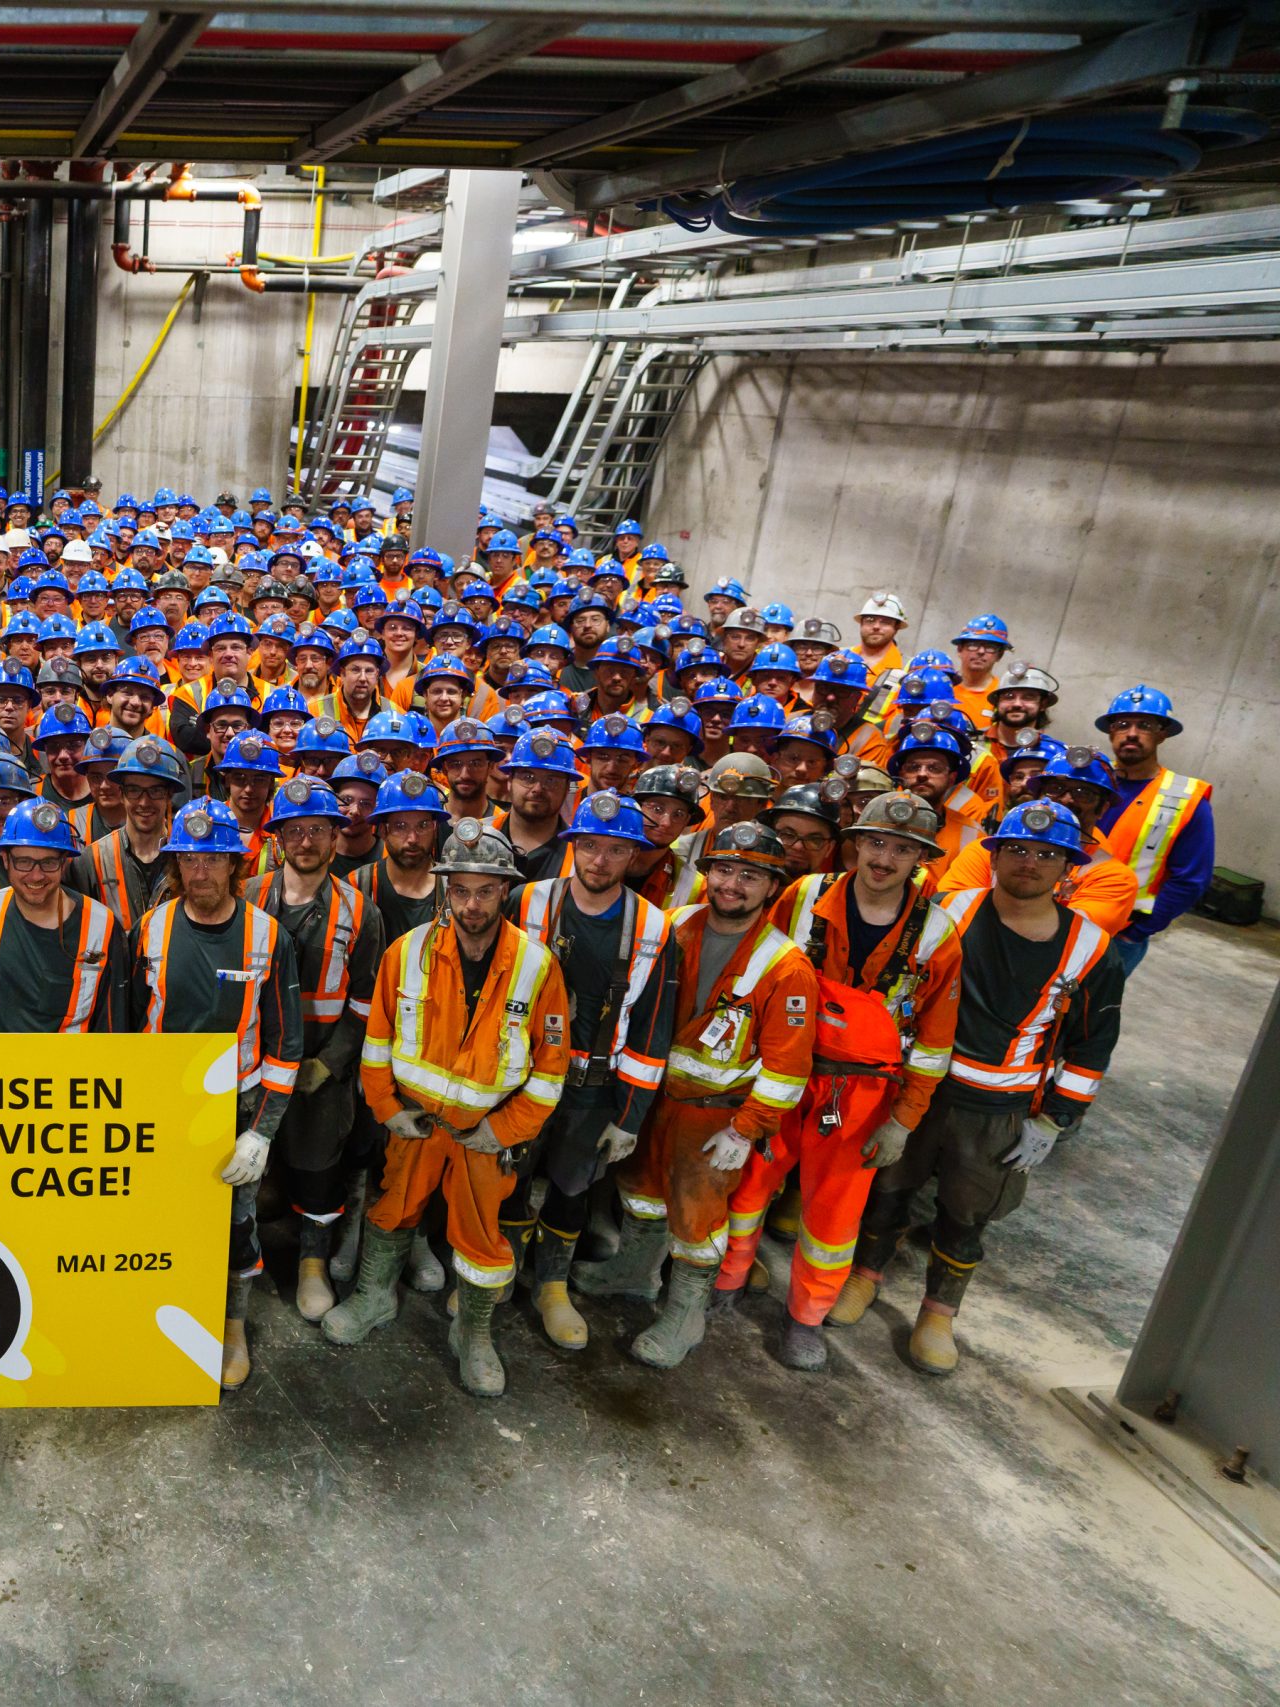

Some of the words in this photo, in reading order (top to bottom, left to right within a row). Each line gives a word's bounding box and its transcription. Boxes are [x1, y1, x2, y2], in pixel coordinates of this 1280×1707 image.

[69, 1078, 123, 1110] EN
[104, 1122, 156, 1154] DE
[10, 1166, 132, 1198] CAGE!
[57, 1254, 106, 1273] MAI
[114, 1252, 173, 1272] 2025
